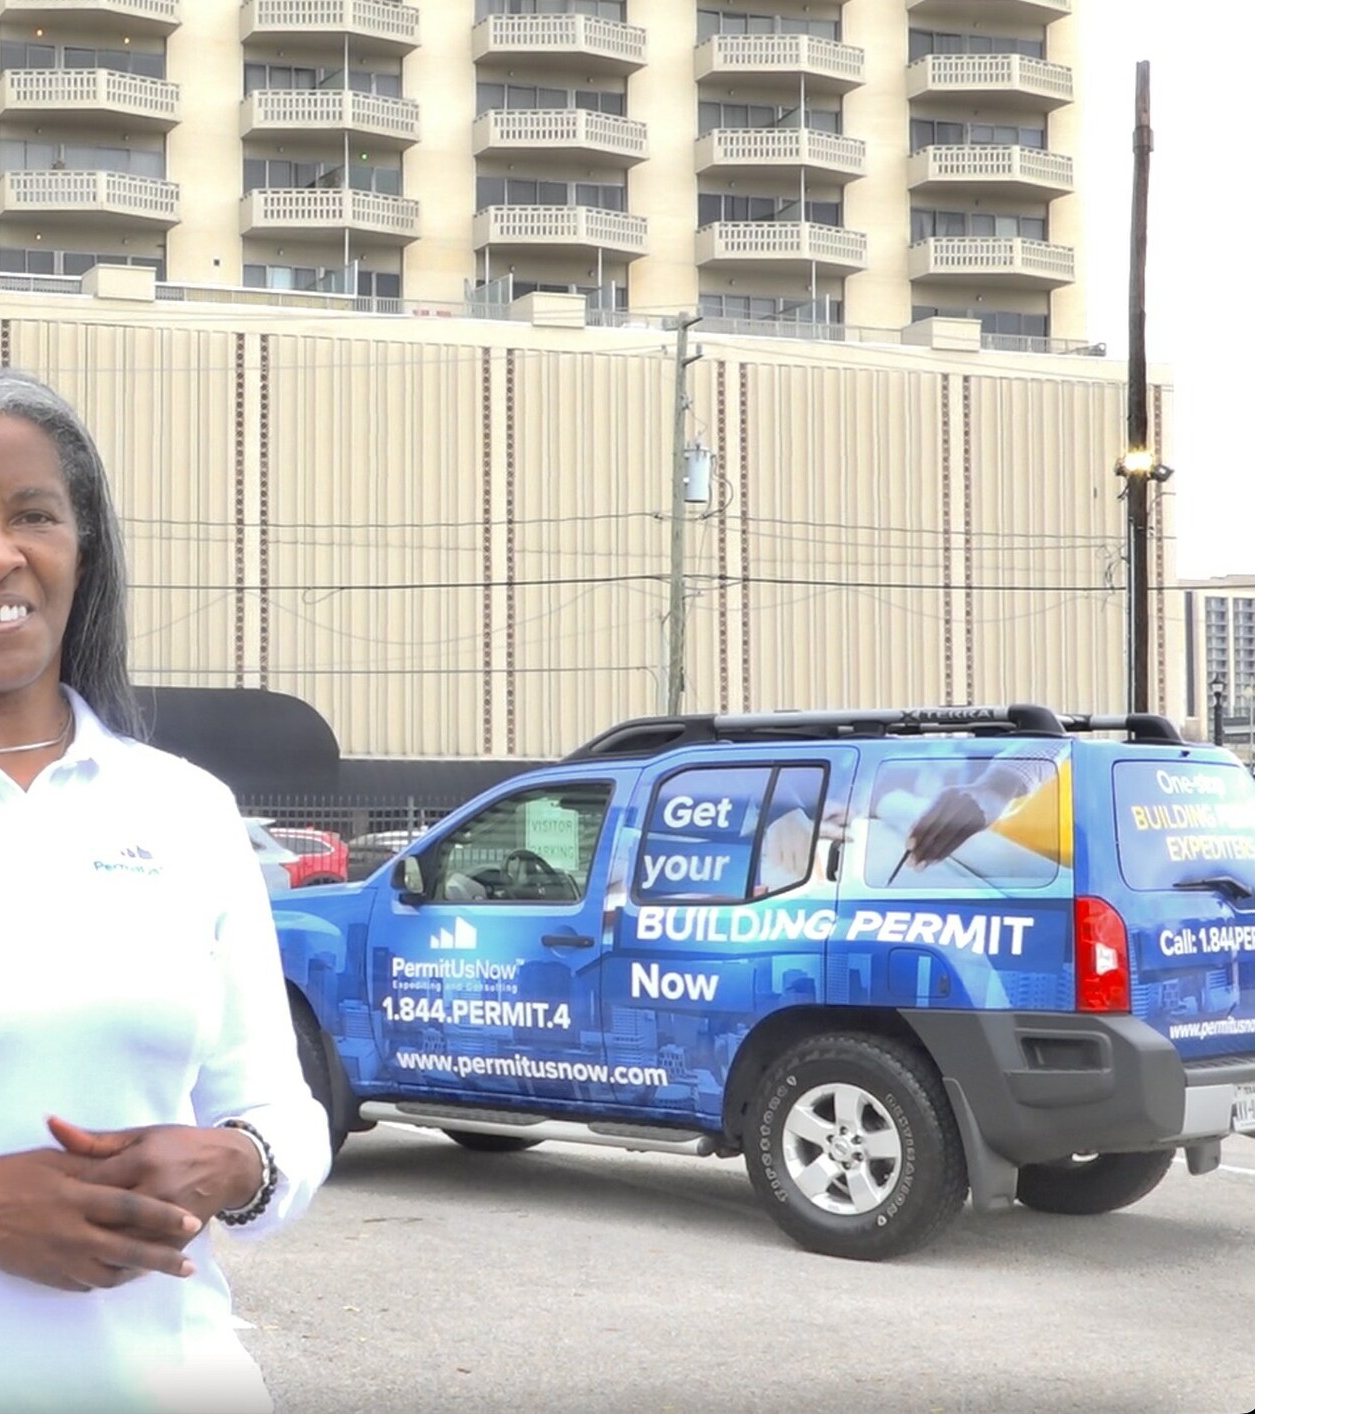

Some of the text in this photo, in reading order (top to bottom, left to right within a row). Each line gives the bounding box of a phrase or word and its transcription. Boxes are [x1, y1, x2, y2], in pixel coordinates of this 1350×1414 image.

[531, 819, 574, 833] VISITOR
[663, 796, 732, 829] Get
[1130, 804, 1215, 831] BUILDING
[641, 854, 730, 888] your
[636, 906, 1035, 956] BUILDING PERMIT
[1159, 928, 1197, 956] Call:
[392, 980, 441, 992] Expediting
[630, 962, 719, 1002] Now
[381, 996, 571, 1029] 1.844.PERMIT.4
[395, 1051, 668, 1086] www.permitusnow.com
